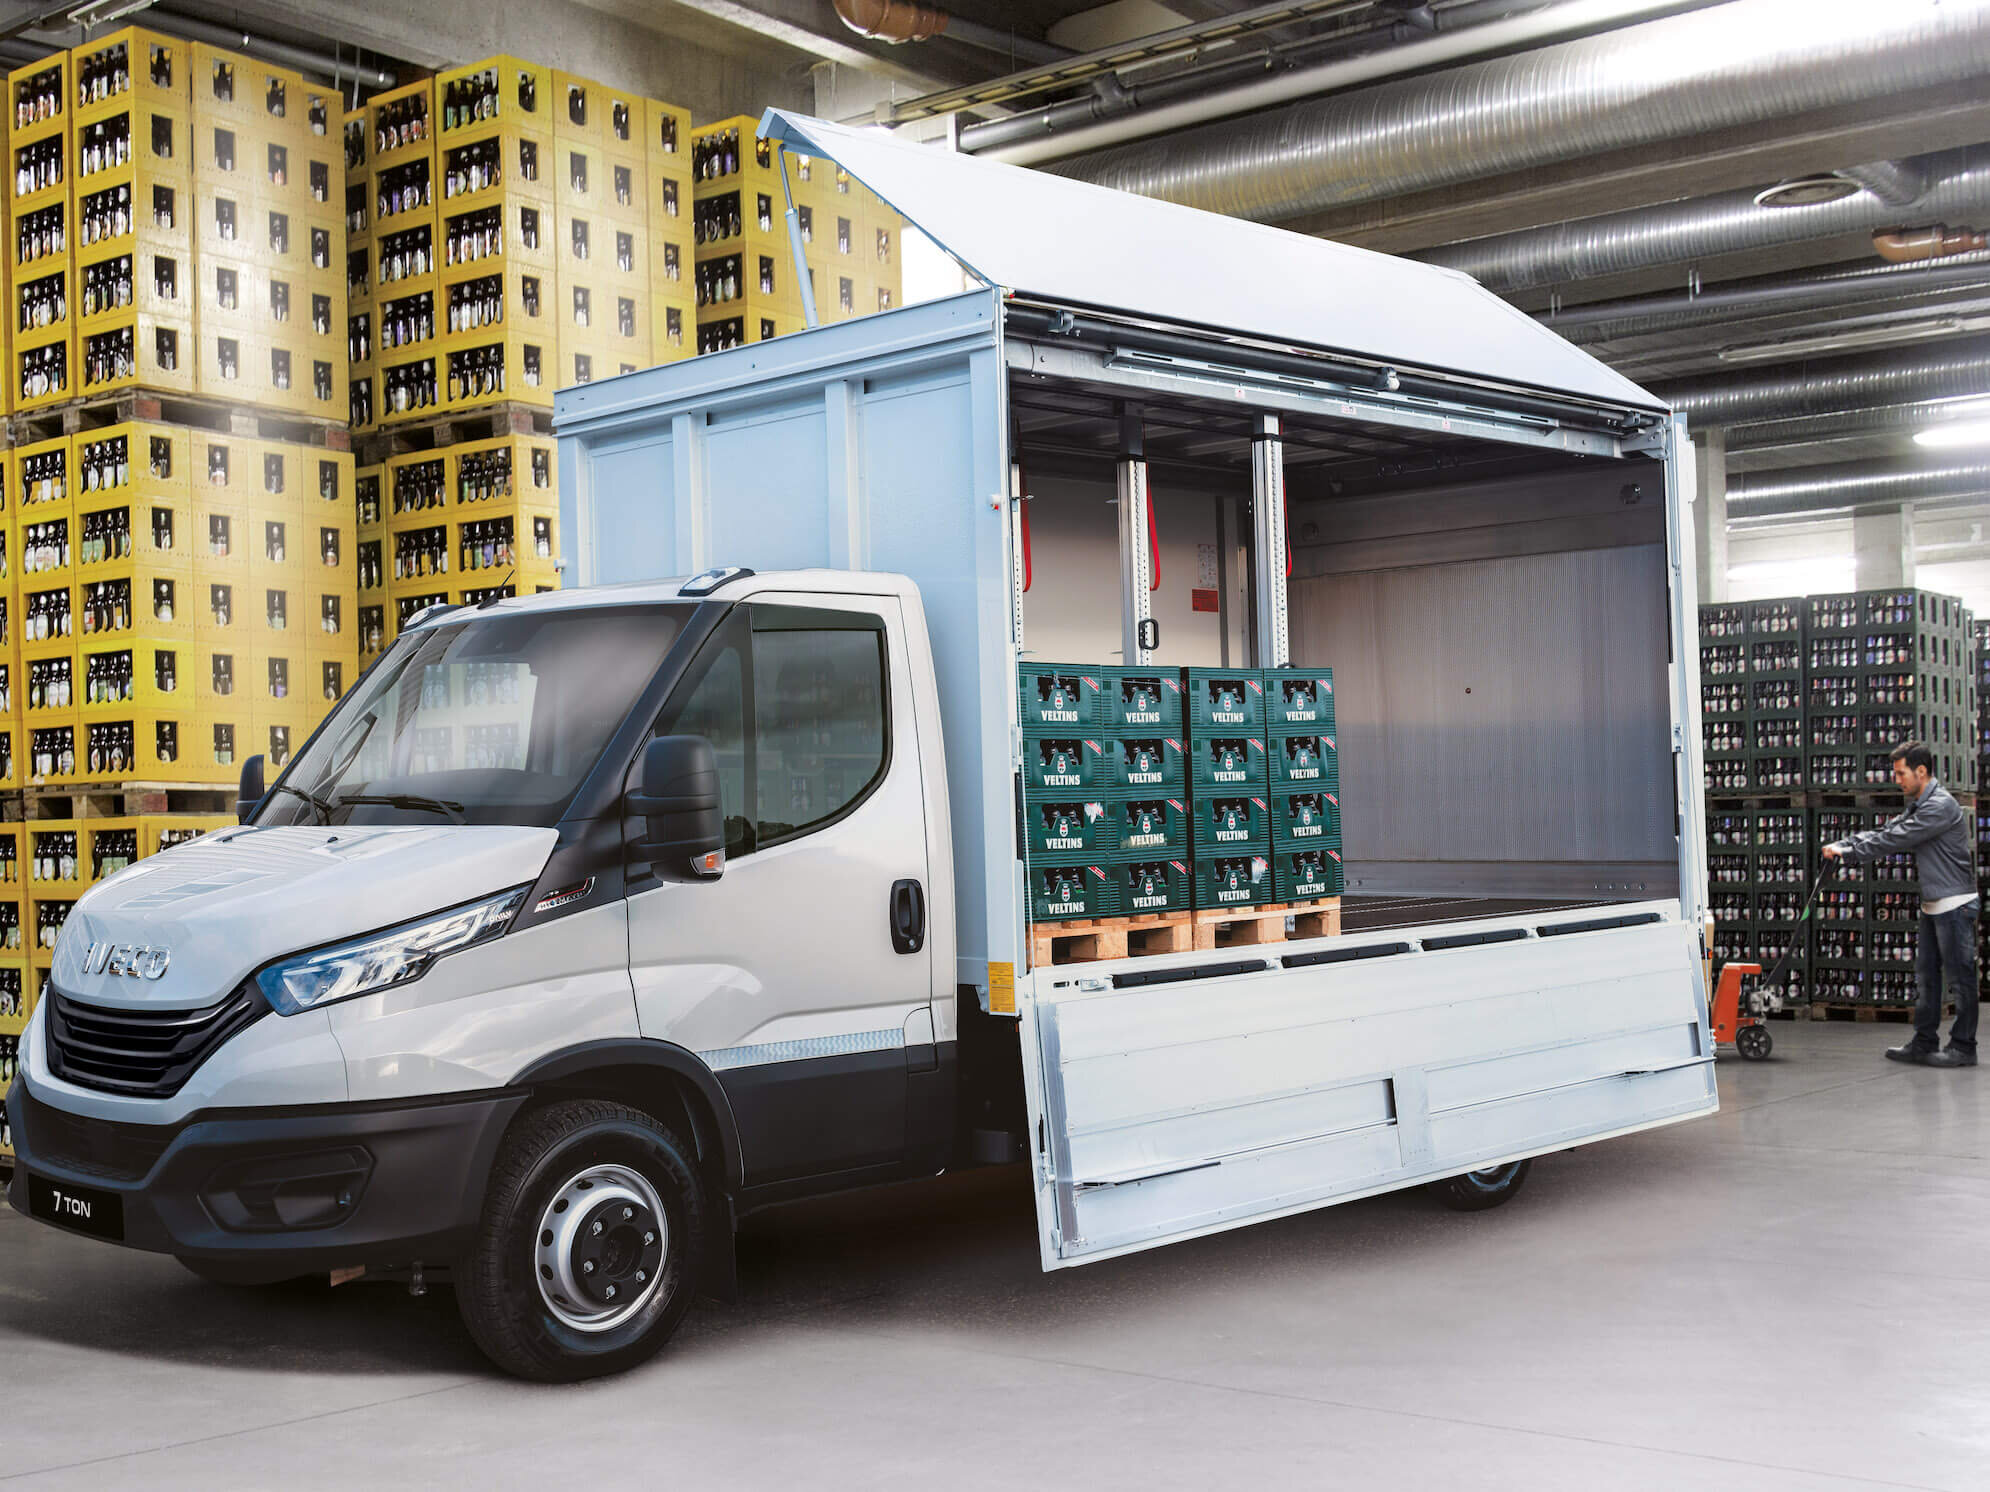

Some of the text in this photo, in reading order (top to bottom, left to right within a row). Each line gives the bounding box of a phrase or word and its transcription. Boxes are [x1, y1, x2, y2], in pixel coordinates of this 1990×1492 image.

[1041, 710, 1078, 722] VELTINS
[1125, 712, 1160, 723] VELTINS
[1212, 712, 1245, 723] VELTINS
[1286, 711, 1316, 721] VELTINS
[1128, 772, 1163, 784] VELTINS
[1213, 771, 1246, 782] VELTINS
[1289, 768, 1320, 779] VELTINS
[1043, 774, 1081, 786] VELTINS
[1216, 830, 1249, 841] VELTINS
[1293, 825, 1322, 837] VELTINS
[1046, 838, 1083, 849] VELTINS
[1130, 833, 1165, 846] VELTINS
[1296, 883, 1325, 895] VELTINS
[1133, 895, 1167, 908] VELTINS
[1218, 889, 1250, 902] VELTINS
[1048, 902, 1085, 914] VELTINS
[82, 943, 171, 981] IVECO
[53, 1190, 91, 1218] 7 TON
